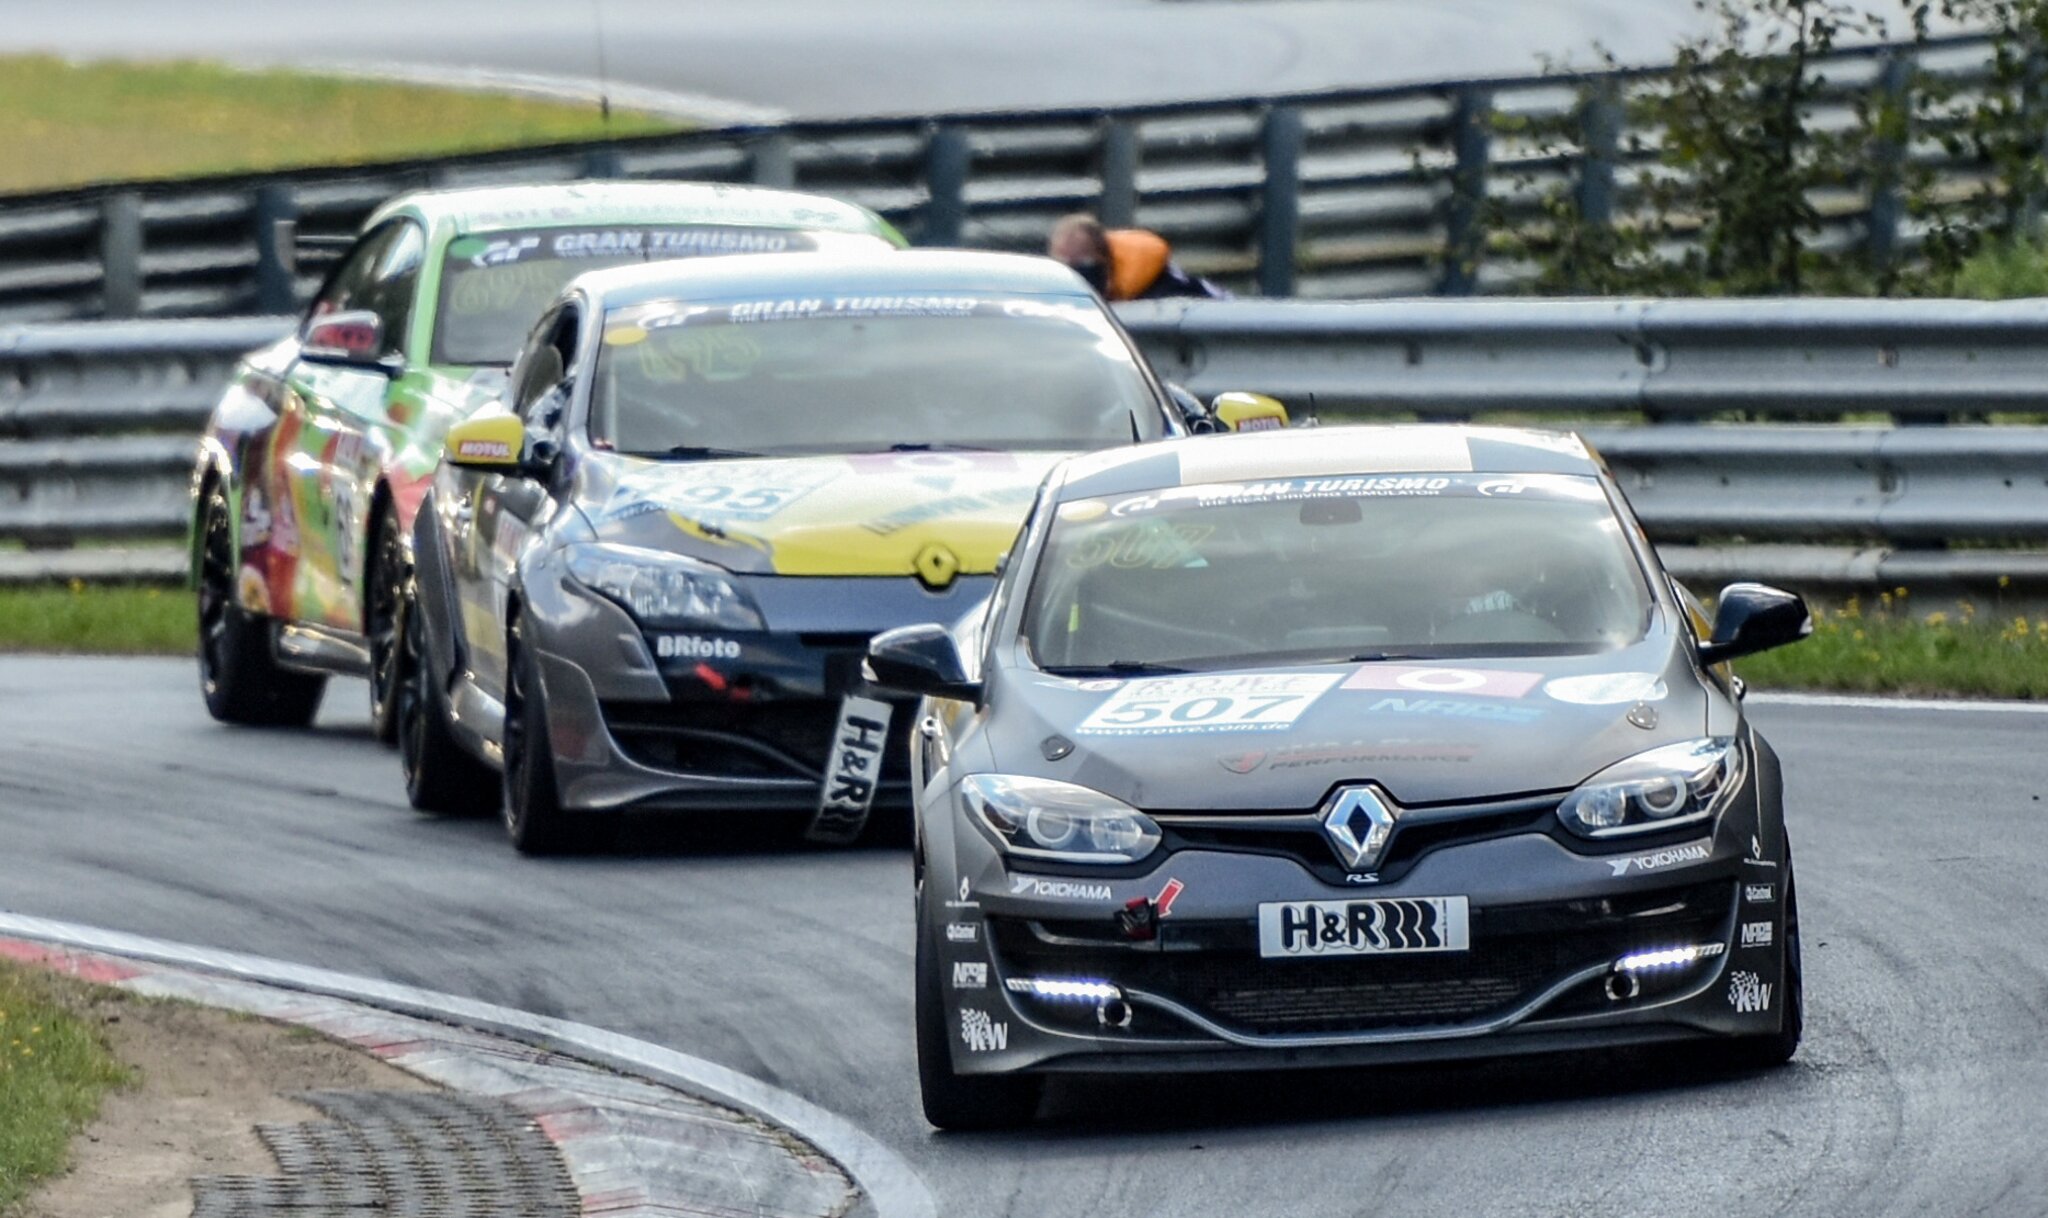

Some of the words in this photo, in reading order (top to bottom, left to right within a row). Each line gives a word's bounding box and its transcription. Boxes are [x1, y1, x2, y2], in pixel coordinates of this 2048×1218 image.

[553, 231, 643, 251] GRAN
[652, 232, 787, 251] TURISMO
[731, 299, 821, 317] GRAN
[835, 297, 978, 311] TURISMO
[460, 442, 510, 457] MOTUL
[1303, 478, 1450, 493] TURISMO
[1231, 495, 1267, 504] REAL
[1275, 489, 1342, 501] DRIVING
[656, 635, 743, 659] BRfoto
[1101, 695, 1305, 724] 507
[1074, 721, 1291, 736] www.rowe.com.de
[1634, 845, 1709, 870] YOKOHAMA
[1346, 873, 1379, 883] RS
[1034, 878, 1112, 900] YOKOHAMA
